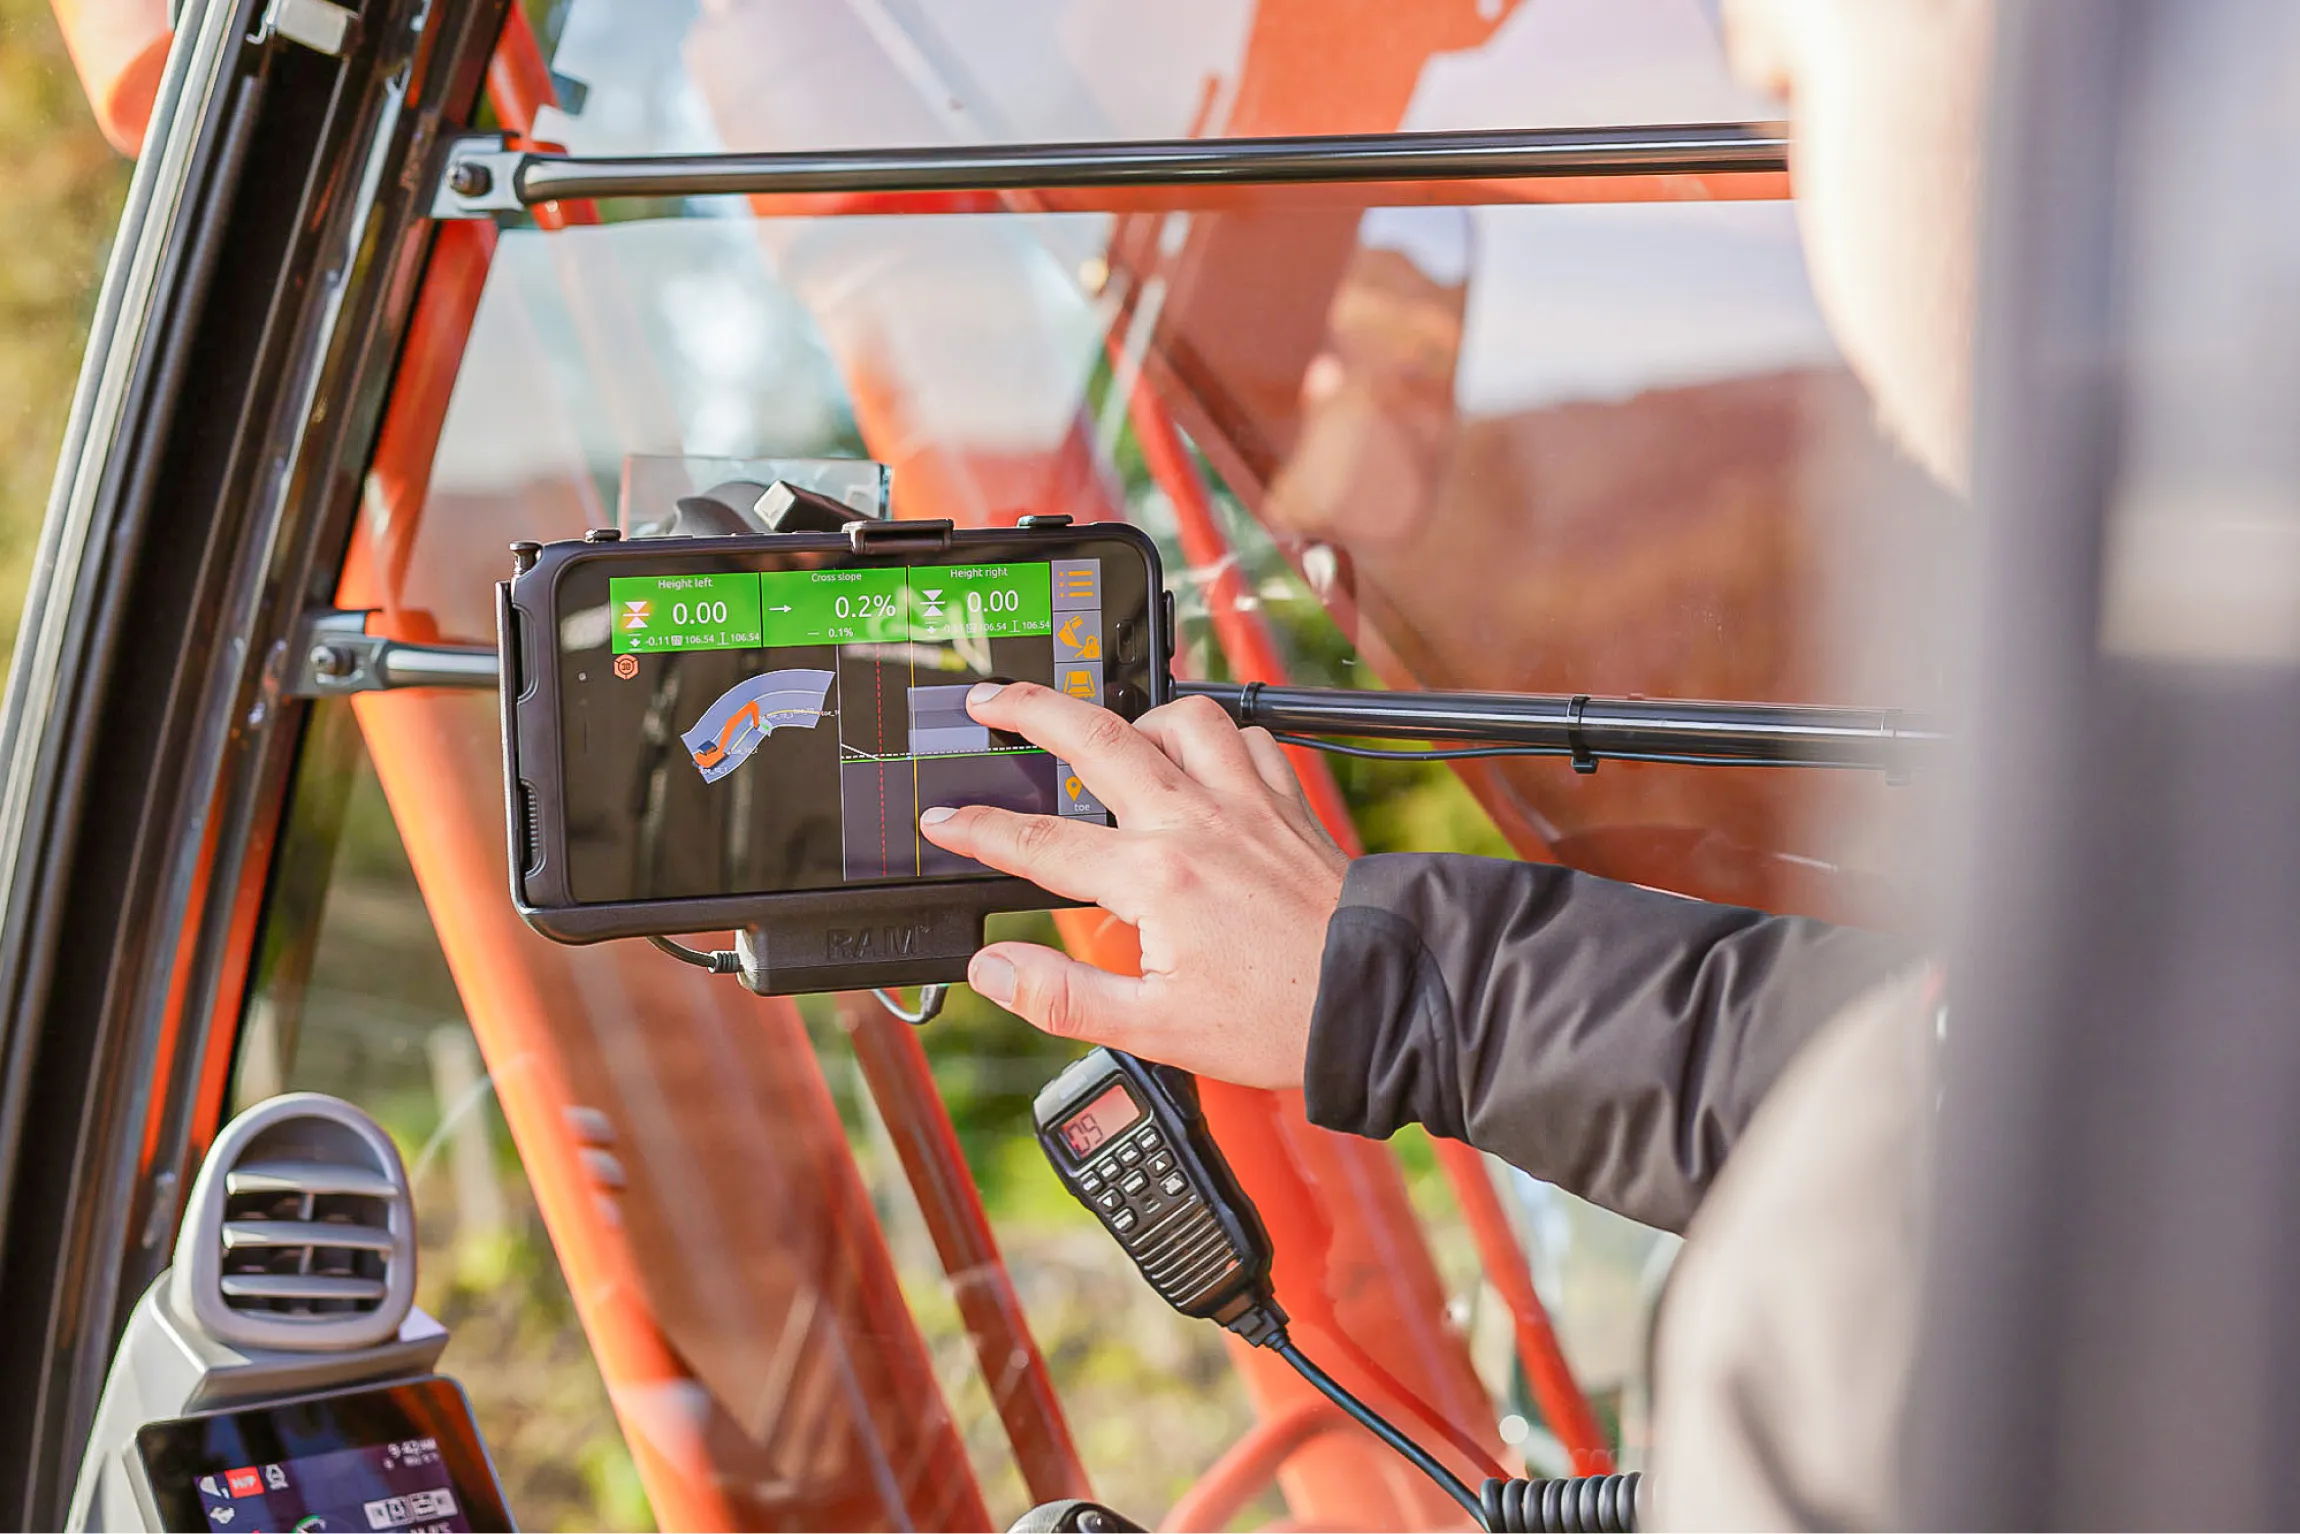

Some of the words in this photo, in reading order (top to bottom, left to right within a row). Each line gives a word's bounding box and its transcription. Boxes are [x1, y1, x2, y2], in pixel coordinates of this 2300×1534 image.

[811, 573, 836, 582] Cross
[838, 572, 862, 582] slope
[950, 568, 983, 580] Height
[985, 567, 1008, 579] right
[658, 579, 692, 590] Height
[695, 577, 713, 588] left
[835, 594, 896, 619] 0.2%
[967, 589, 1018, 613] 0.00
[672, 601, 727, 625] 0.00
[1022, 620, 1050, 630] 106.54
[685, 633, 715, 644] 106.54
[731, 631, 760, 642] 106.54
[828, 626, 854, 638] 0.1%
[1073, 803, 1091, 812] toe
